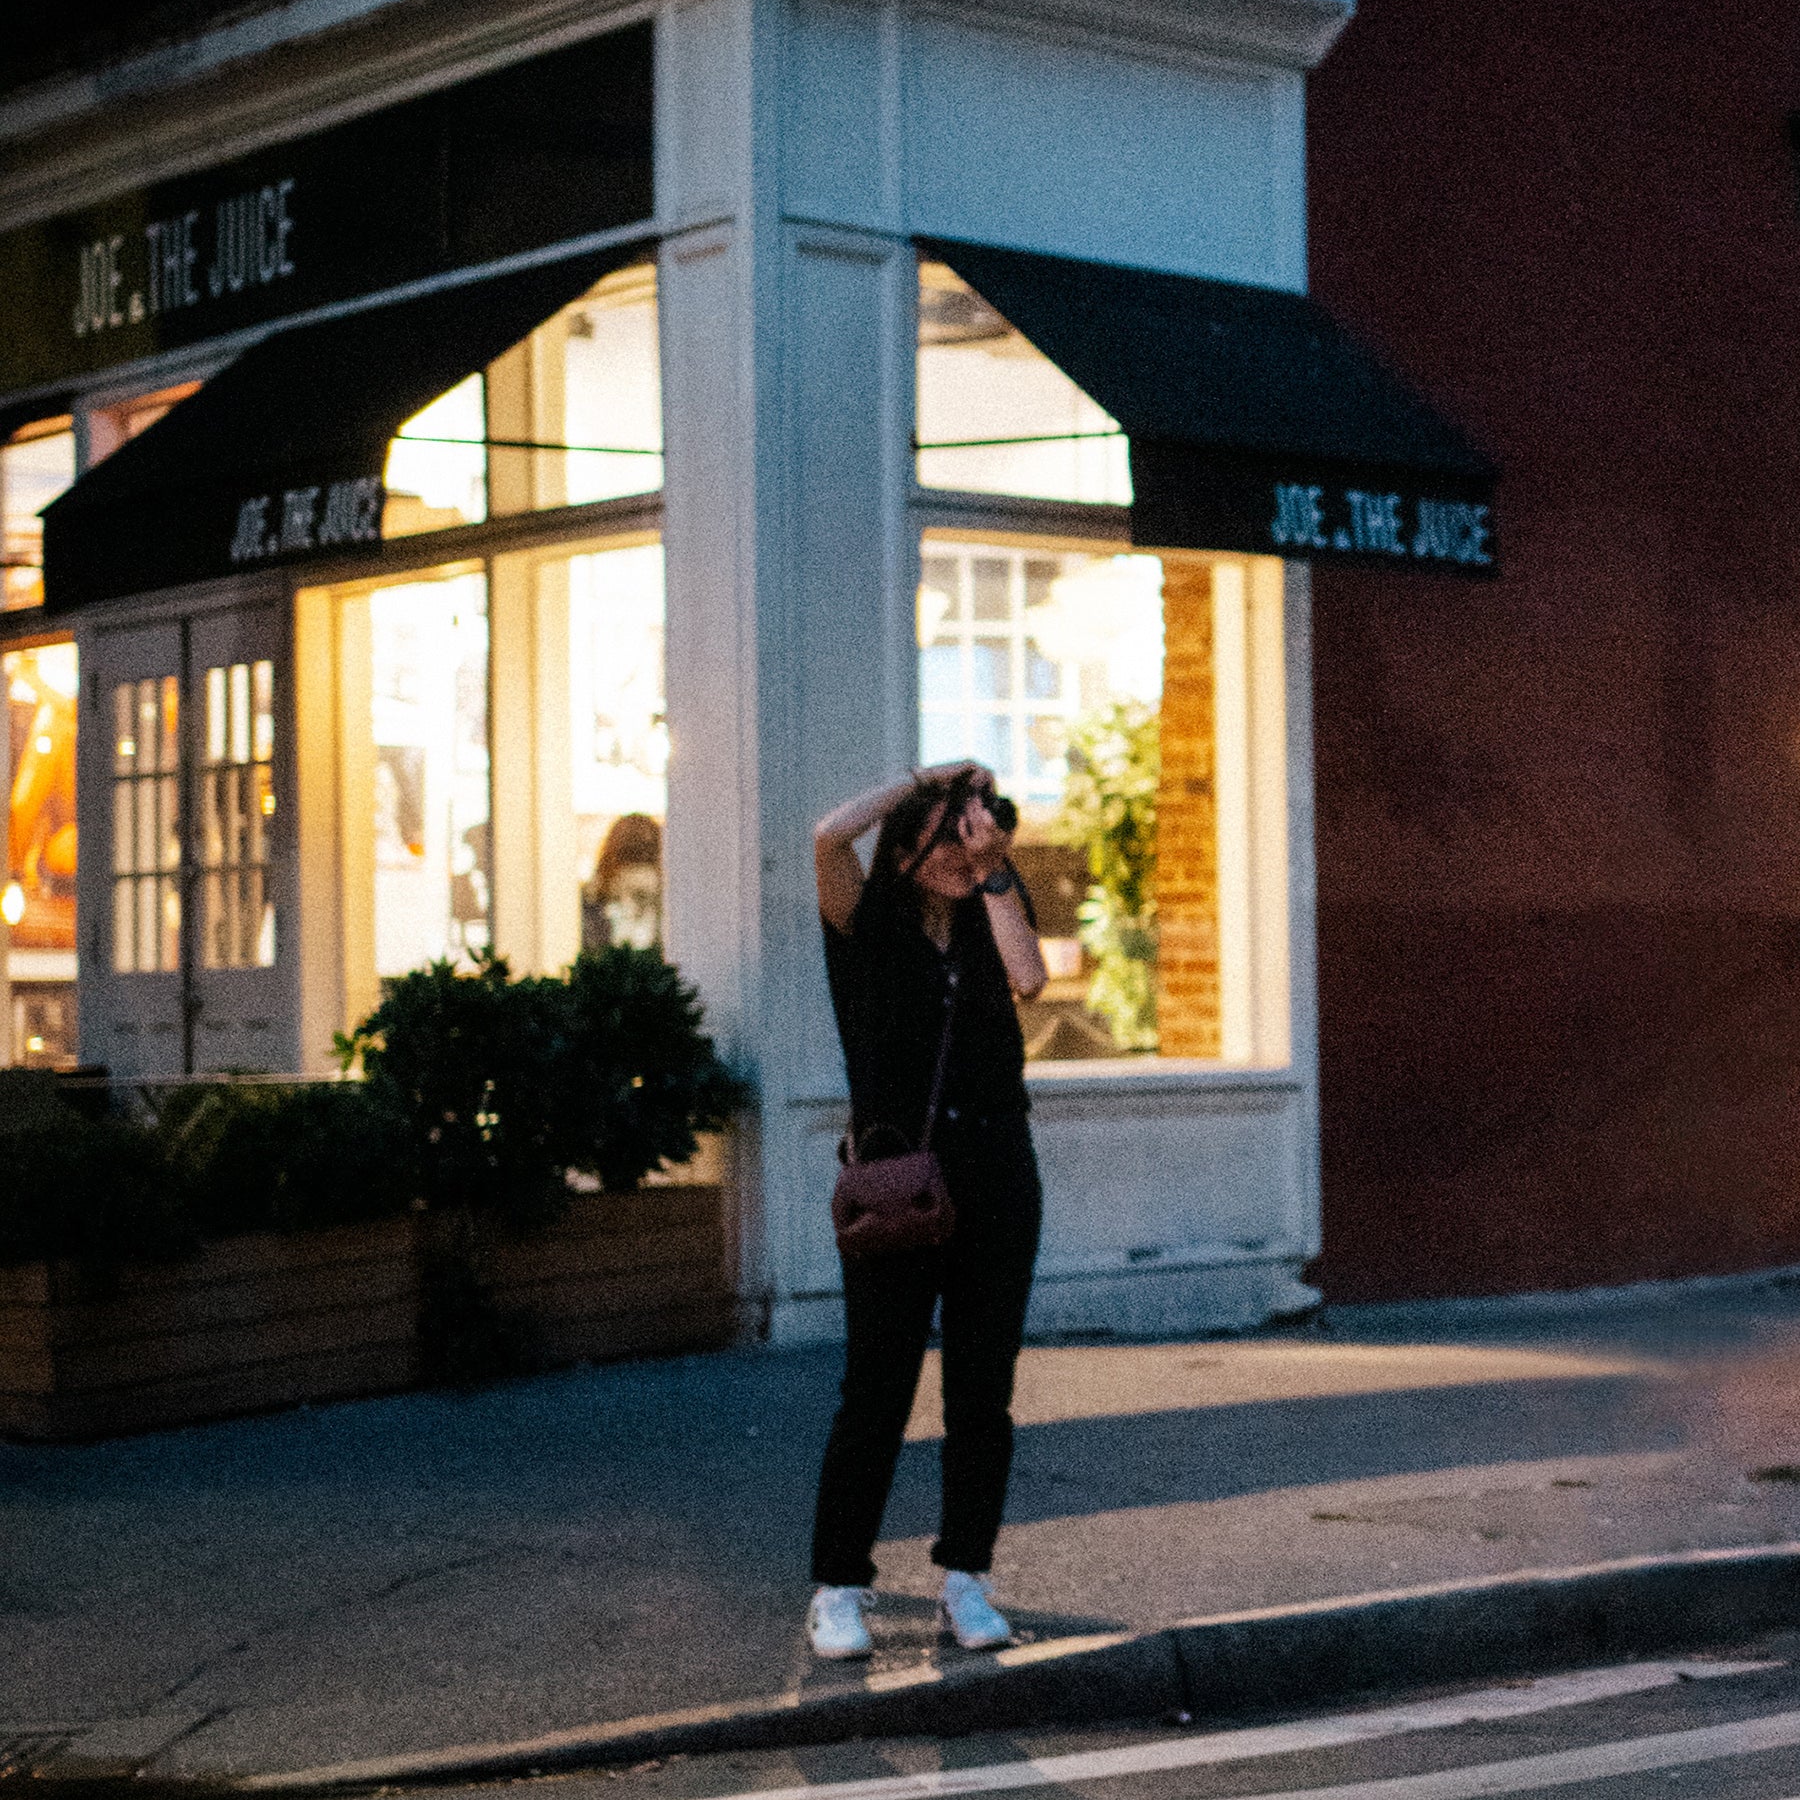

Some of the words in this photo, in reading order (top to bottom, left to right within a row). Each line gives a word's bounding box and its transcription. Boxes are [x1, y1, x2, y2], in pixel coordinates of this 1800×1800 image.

[72, 234, 124, 337] JOE
[145, 208, 200, 316] THE
[208, 176, 296, 298] JUICE
[1270, 482, 1328, 548] JOE
[1345, 489, 1406, 555] THE
[1412, 497, 1492, 564] JUICE
